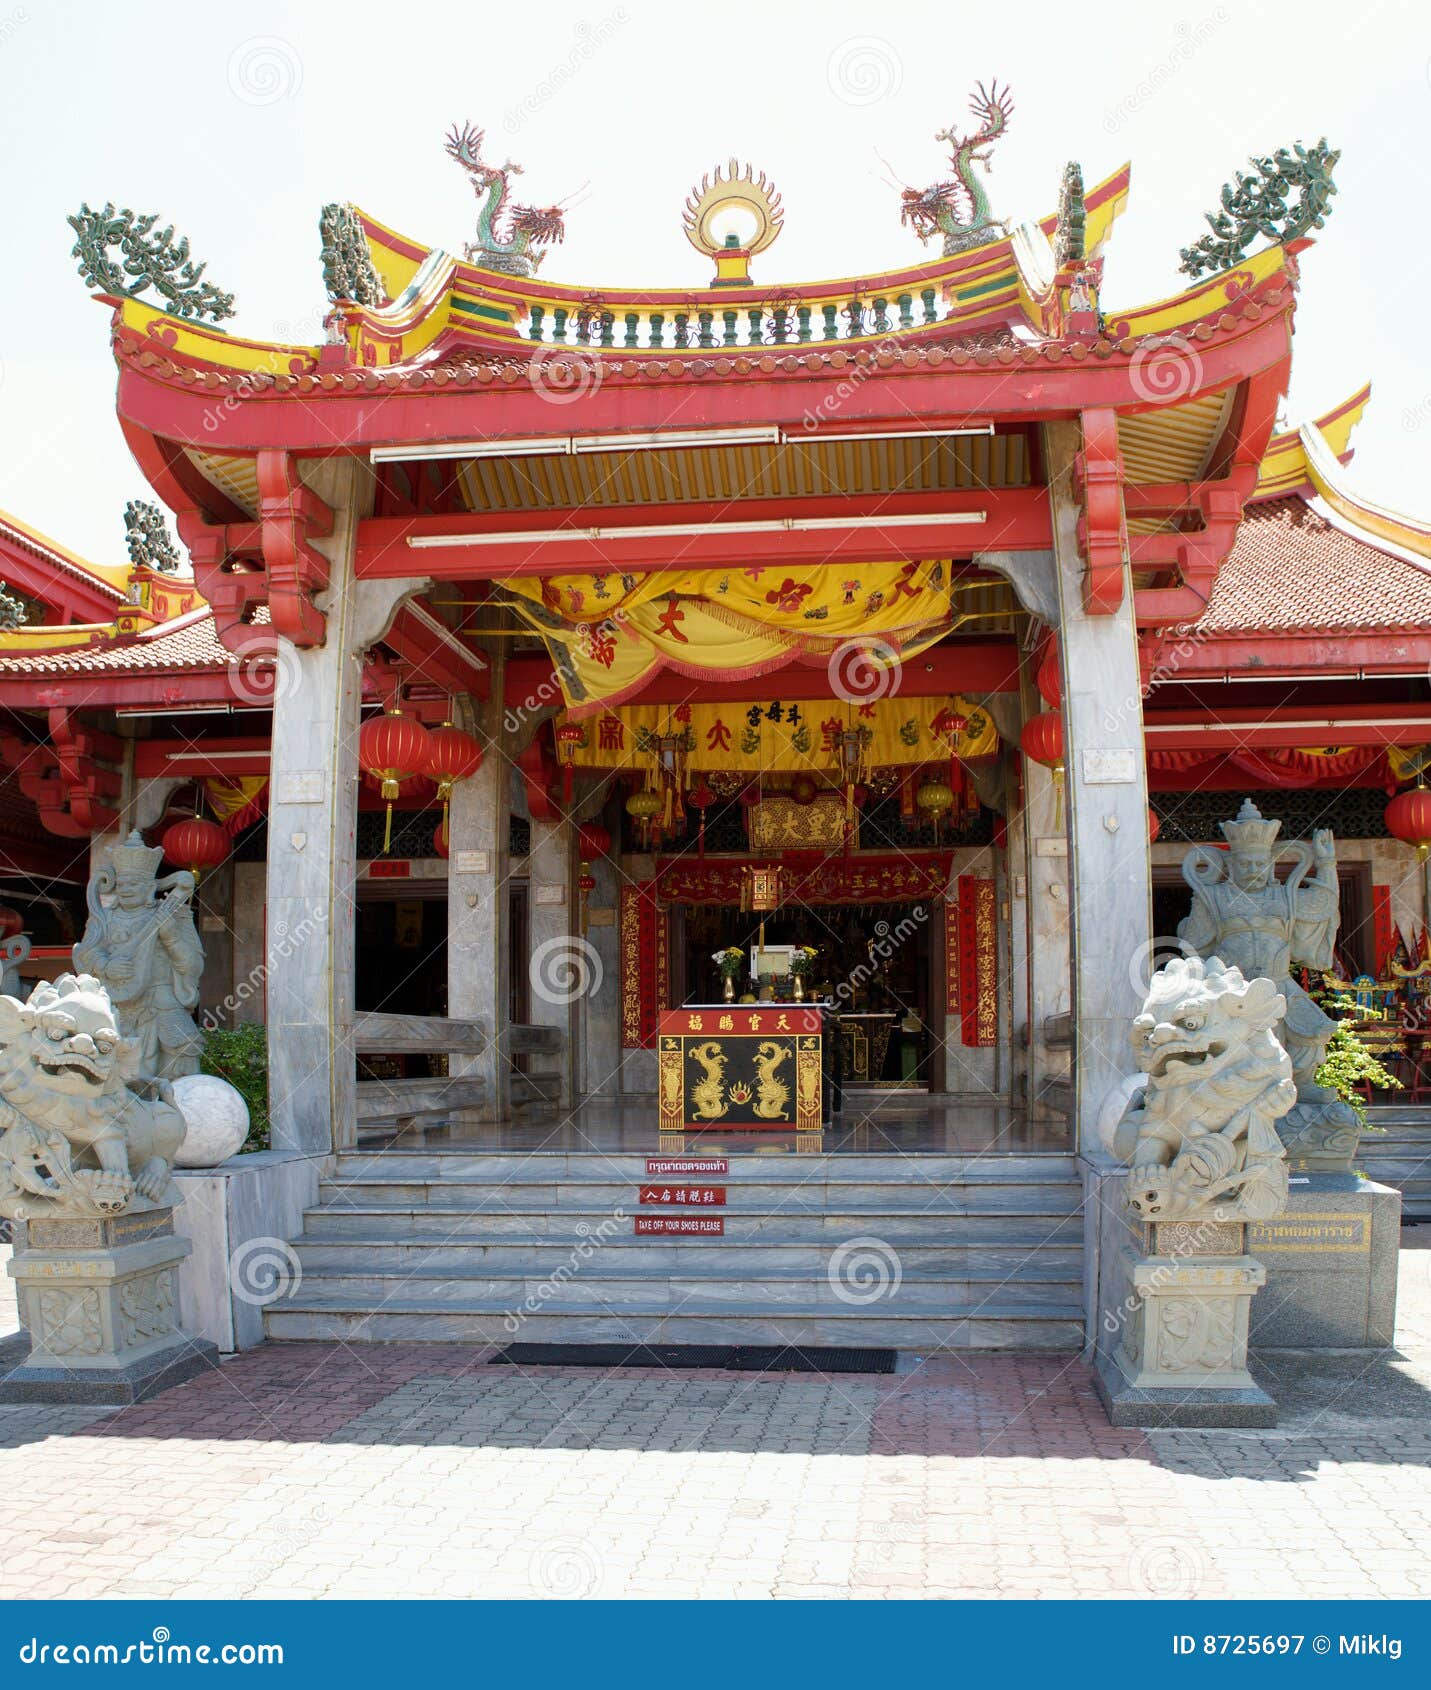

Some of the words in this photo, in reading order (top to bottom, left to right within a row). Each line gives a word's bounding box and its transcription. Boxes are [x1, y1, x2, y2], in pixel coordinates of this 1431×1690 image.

[649, 1160, 725, 1172] กรุณาถอดรองเท้า
[639, 1221, 652, 1230] TAKE
[653, 1221, 663, 1230] OFF
[665, 1221, 679, 1230] YOUR
[681, 1221, 699, 1230] SHOES
[700, 1221, 720, 1231] PLEASE
